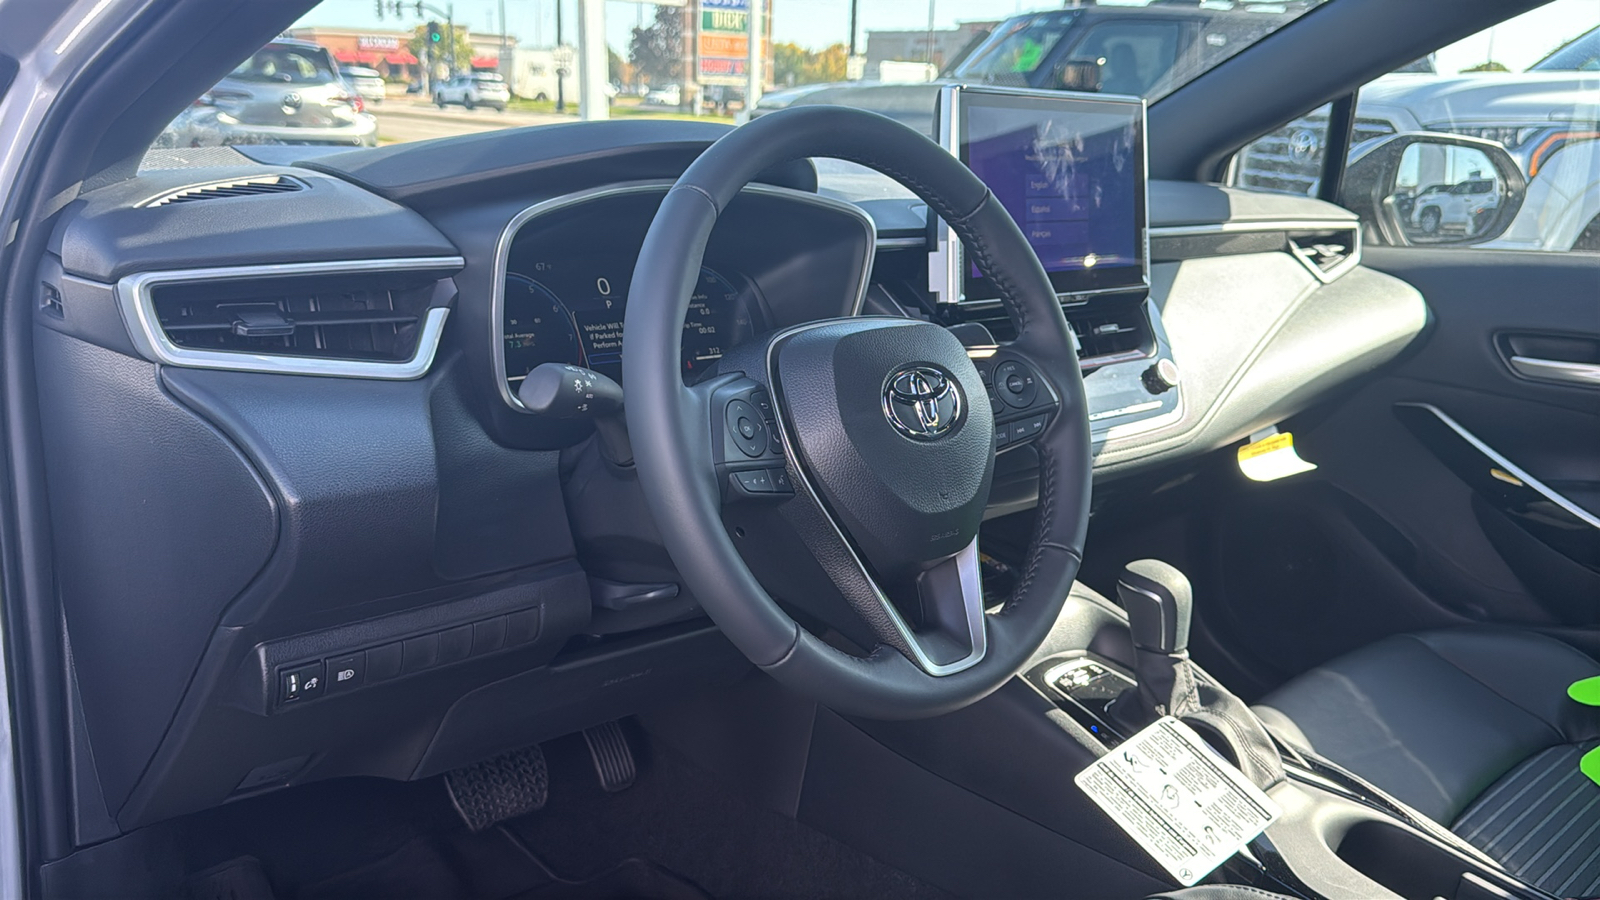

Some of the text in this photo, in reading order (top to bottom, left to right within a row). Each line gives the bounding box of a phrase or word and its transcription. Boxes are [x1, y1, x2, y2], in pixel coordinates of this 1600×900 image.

[535, 262, 545, 271] 67
[529, 285, 535, 294] 5
[597, 277, 611, 295] 0
[553, 305, 559, 313] 6
[606, 300, 612, 309] P
[584, 323, 606, 332] Vehicle
[606, 322, 620, 330] Will
[698, 326, 716, 334] 00:02
[595, 332, 616, 340] Parked
[593, 341, 617, 349] Perform
